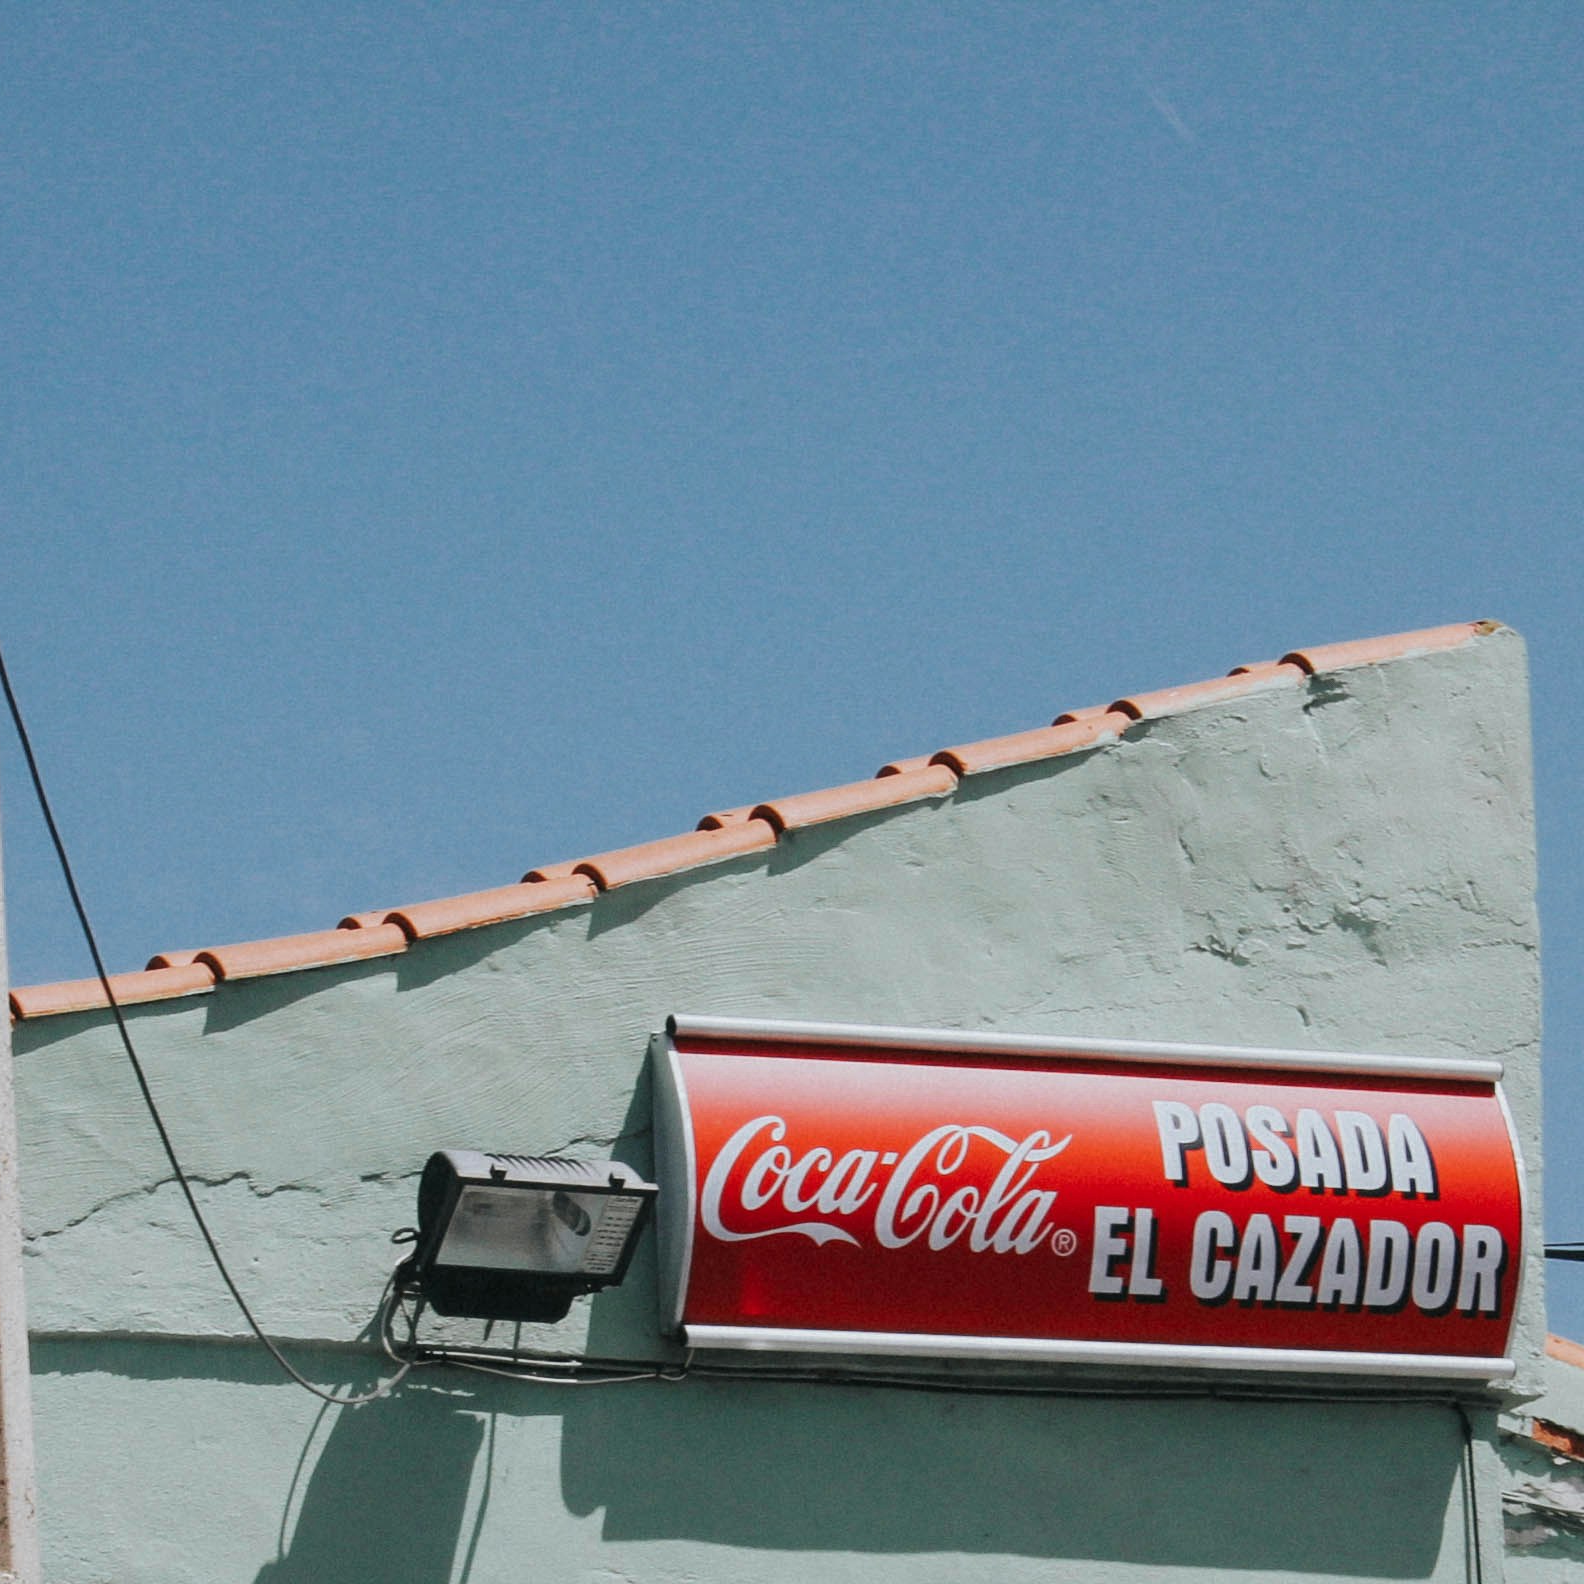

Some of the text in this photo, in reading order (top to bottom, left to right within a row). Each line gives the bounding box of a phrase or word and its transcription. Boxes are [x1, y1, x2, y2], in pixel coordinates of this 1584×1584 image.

[701, 1115, 1073, 1255] Coca-Cola
[1152, 1100, 1438, 1198] POSADA
[1088, 1205, 1506, 1315] EL CAZADOR
